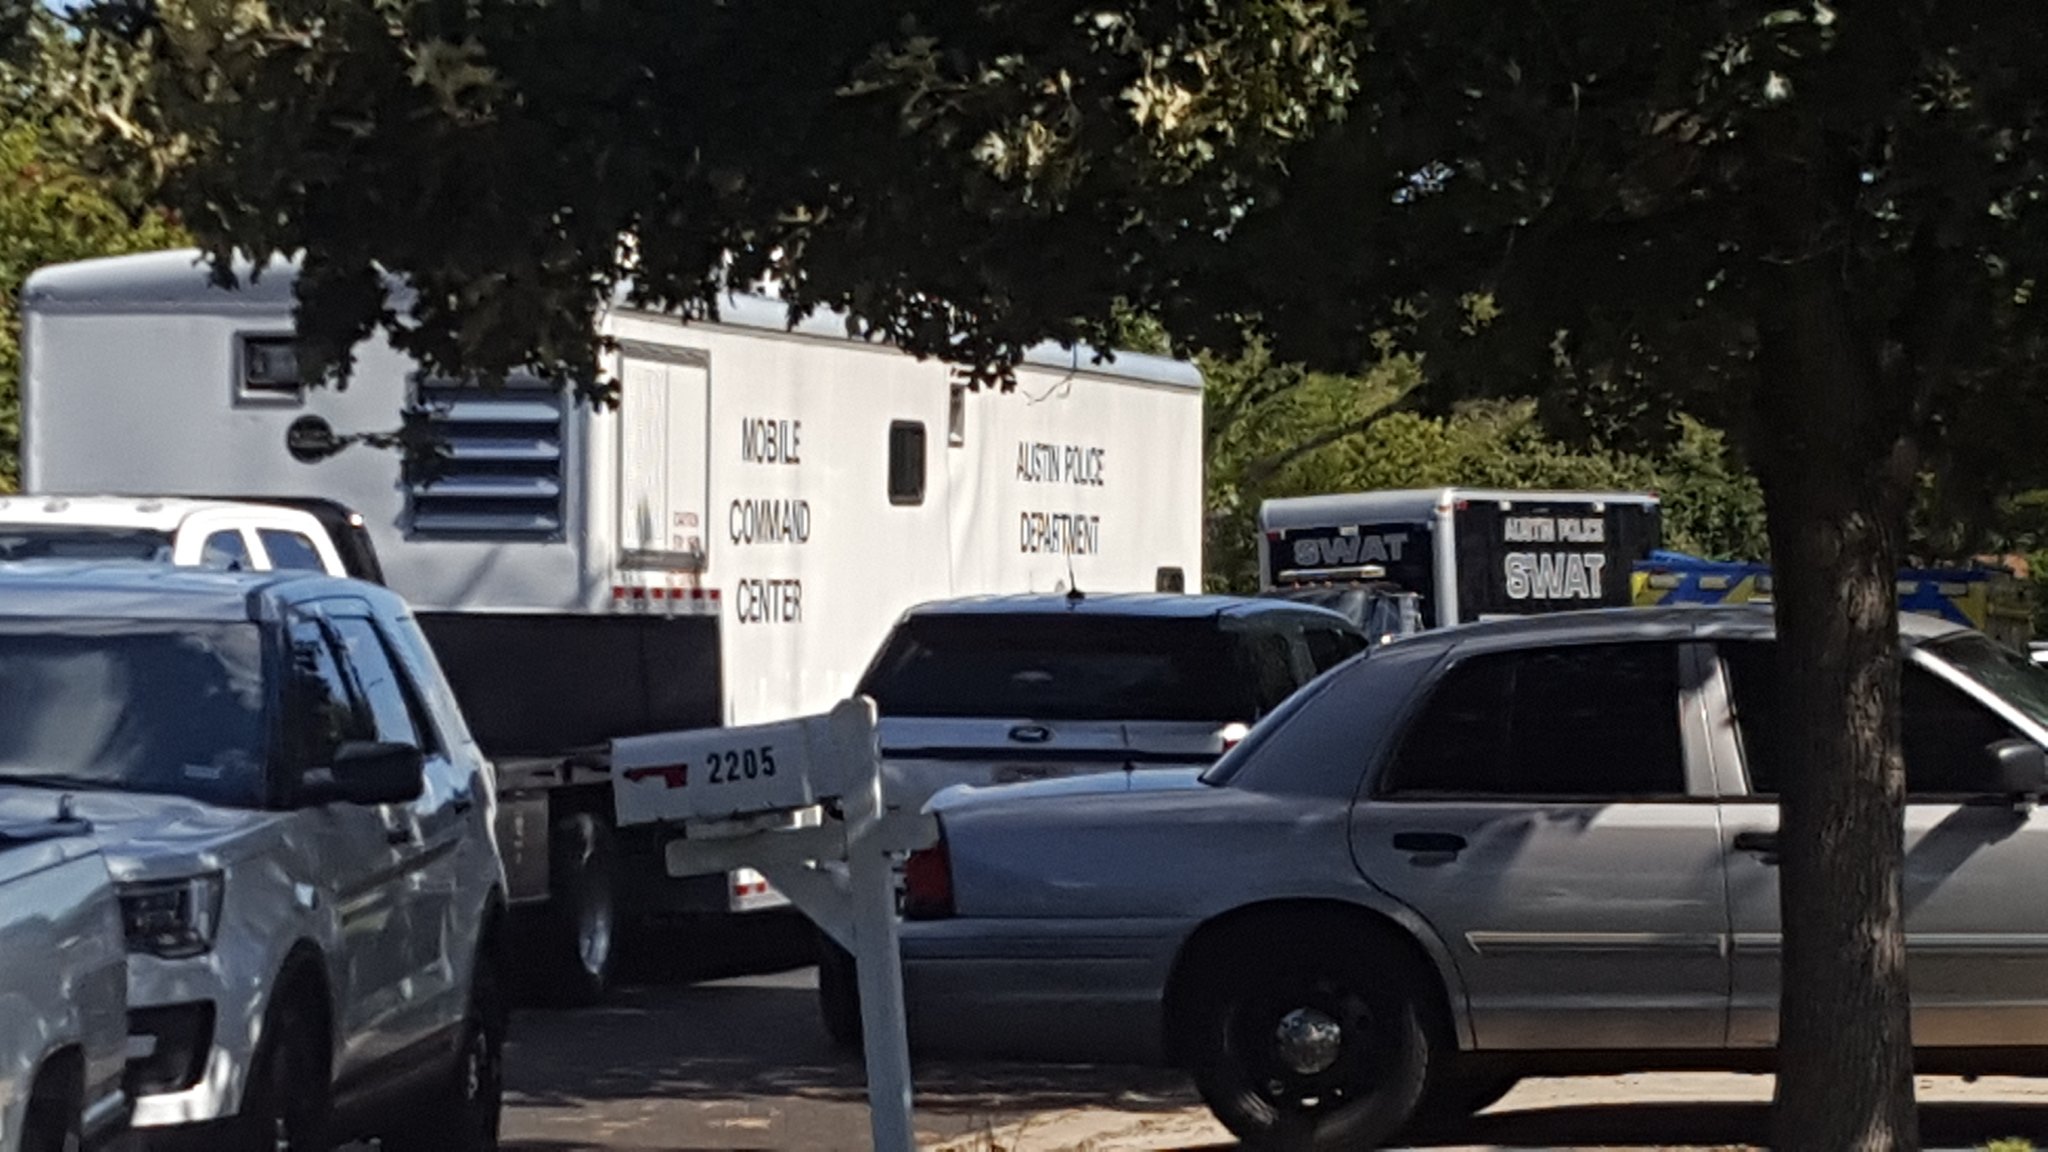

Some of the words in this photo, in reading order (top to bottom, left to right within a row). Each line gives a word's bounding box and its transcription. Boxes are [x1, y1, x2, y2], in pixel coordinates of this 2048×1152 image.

[742, 417, 801, 464] MOBILE
[1017, 441, 1060, 482] AUSTIN
[1065, 445, 1105, 486] POLICE
[729, 499, 811, 545] COMMAND
[1020, 511, 1101, 555] DEPARTMENT
[1504, 516, 1555, 542] AUSTIN
[1557, 516, 1605, 542] POLICE
[1293, 532, 1409, 566] SWAT
[1504, 552, 1606, 599] SWAT
[736, 577, 803, 624] CENTER
[706, 746, 776, 784] 2205
